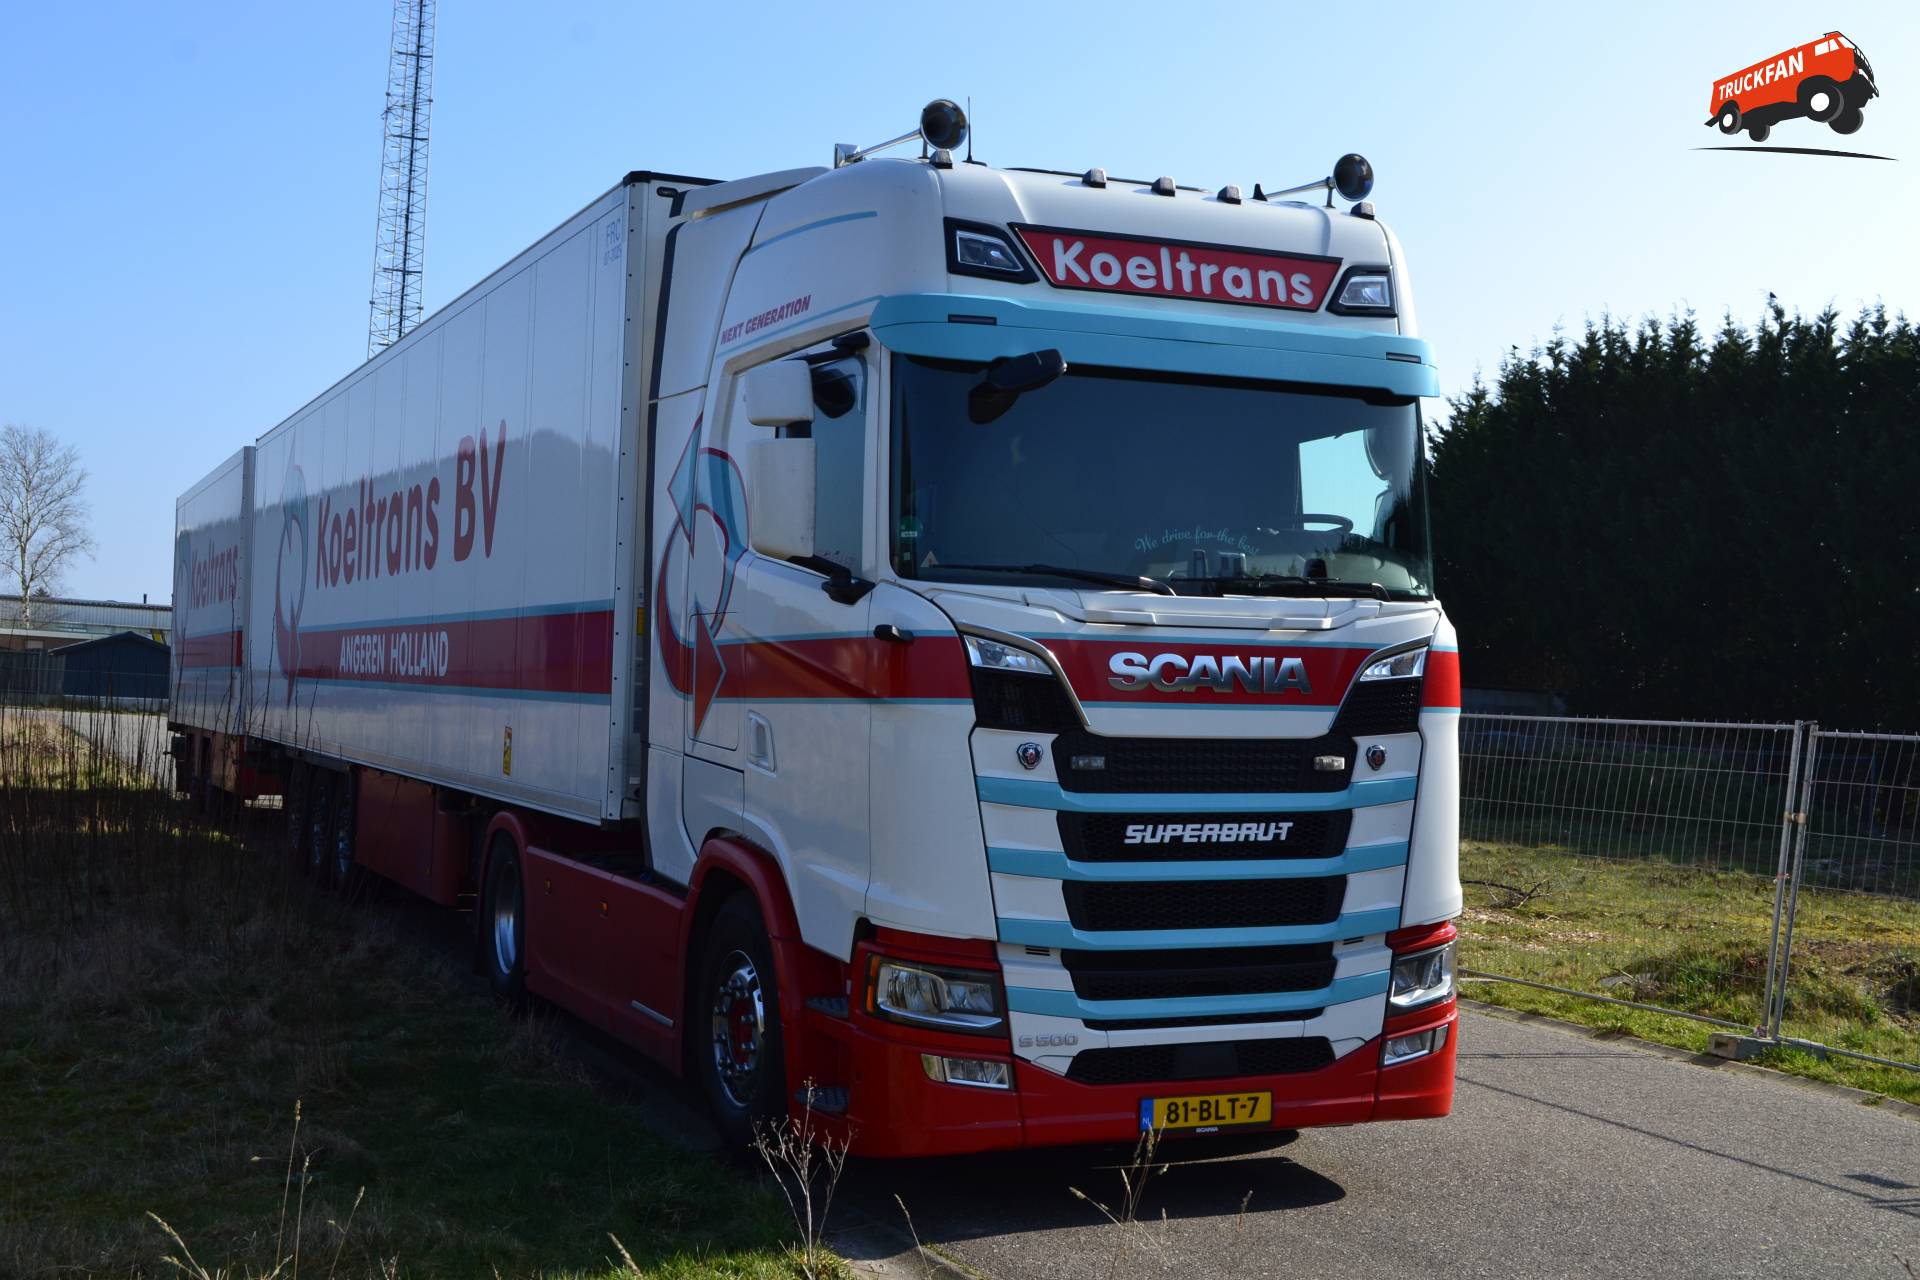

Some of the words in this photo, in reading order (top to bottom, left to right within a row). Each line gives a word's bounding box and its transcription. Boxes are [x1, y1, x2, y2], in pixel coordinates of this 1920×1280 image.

[1053, 238, 1314, 304] Koeltrans
[721, 322, 744, 345] NEXT
[745, 294, 812, 334] GENERATION
[316, 474, 440, 590] Koeltrans
[454, 418, 507, 562] BV
[340, 634, 386, 675] ANGEREN
[390, 631, 449, 677] HOLLAND
[1108, 651, 1313, 695] SCANIA
[1123, 821, 1294, 845] SUPERBRUT
[1166, 1097, 1260, 1124] 81-BLT-7
